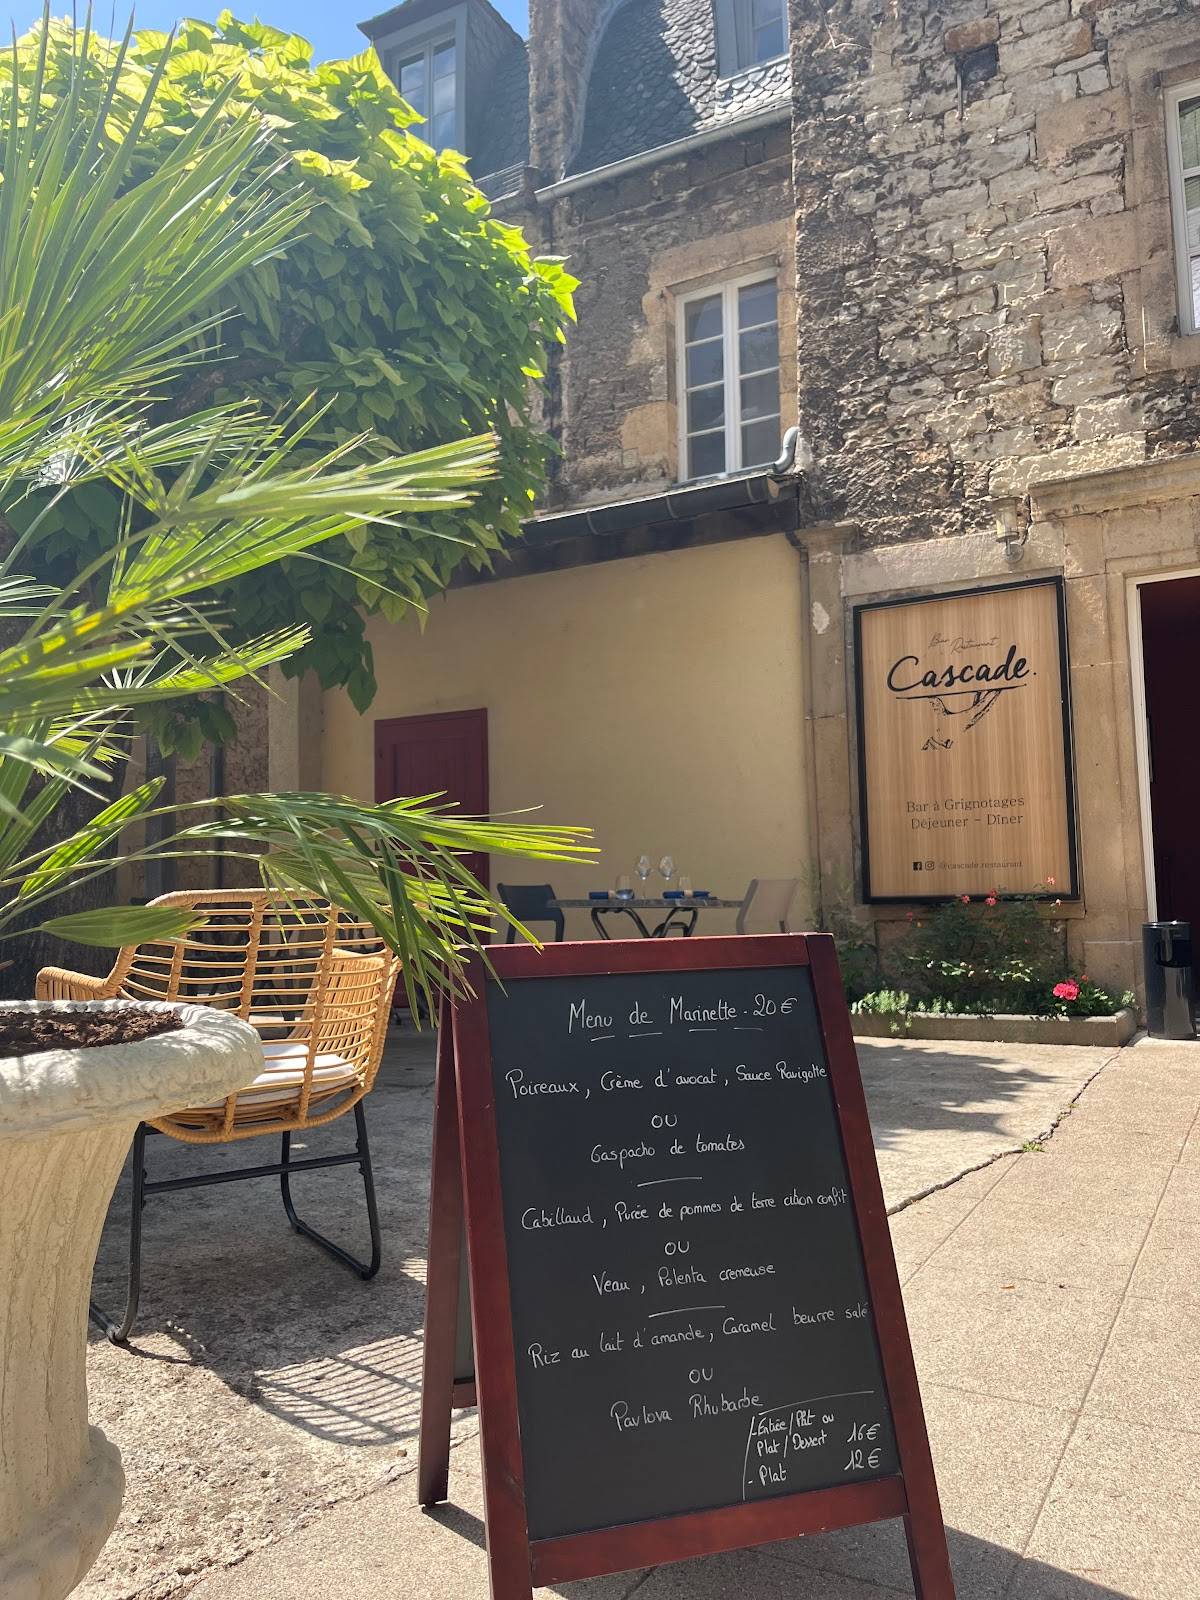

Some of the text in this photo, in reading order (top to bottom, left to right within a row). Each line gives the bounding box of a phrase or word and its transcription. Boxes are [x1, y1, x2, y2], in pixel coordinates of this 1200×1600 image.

[906, 801, 929, 813] Bar
[944, 797, 1025, 811] Grignotages
[911, 817, 968, 830] Déjeuner
[568, 999, 613, 1034] Menu
[629, 1002, 653, 1025] de
[670, 996, 737, 1024] Marinette
[600, 1071, 643, 1091] Crème
[735, 1064, 772, 1081] Sauce
[775, 1060, 828, 1084] Ravigotte
[590, 1133, 745, 1169] Gaspacho de tomates
[614, 1202, 649, 1222] Purée
[658, 1203, 672, 1219] de
[680, 1203, 722, 1221] pommes
[730, 1195, 744, 1213] de
[751, 1191, 776, 1209] terre
[816, 1186, 847, 1207] confit
[658, 1266, 707, 1288] Polenta
[528, 1342, 561, 1368] Riz
[571, 1347, 590, 1360] au
[600, 1332, 625, 1353] lait
[722, 1313, 776, 1336] Caramel
[792, 1305, 835, 1325] beurre
[845, 1301, 868, 1319] salé
[610, 1386, 763, 1432] Pavlova Rhubarbe
[759, 1462, 787, 1486] Plat
